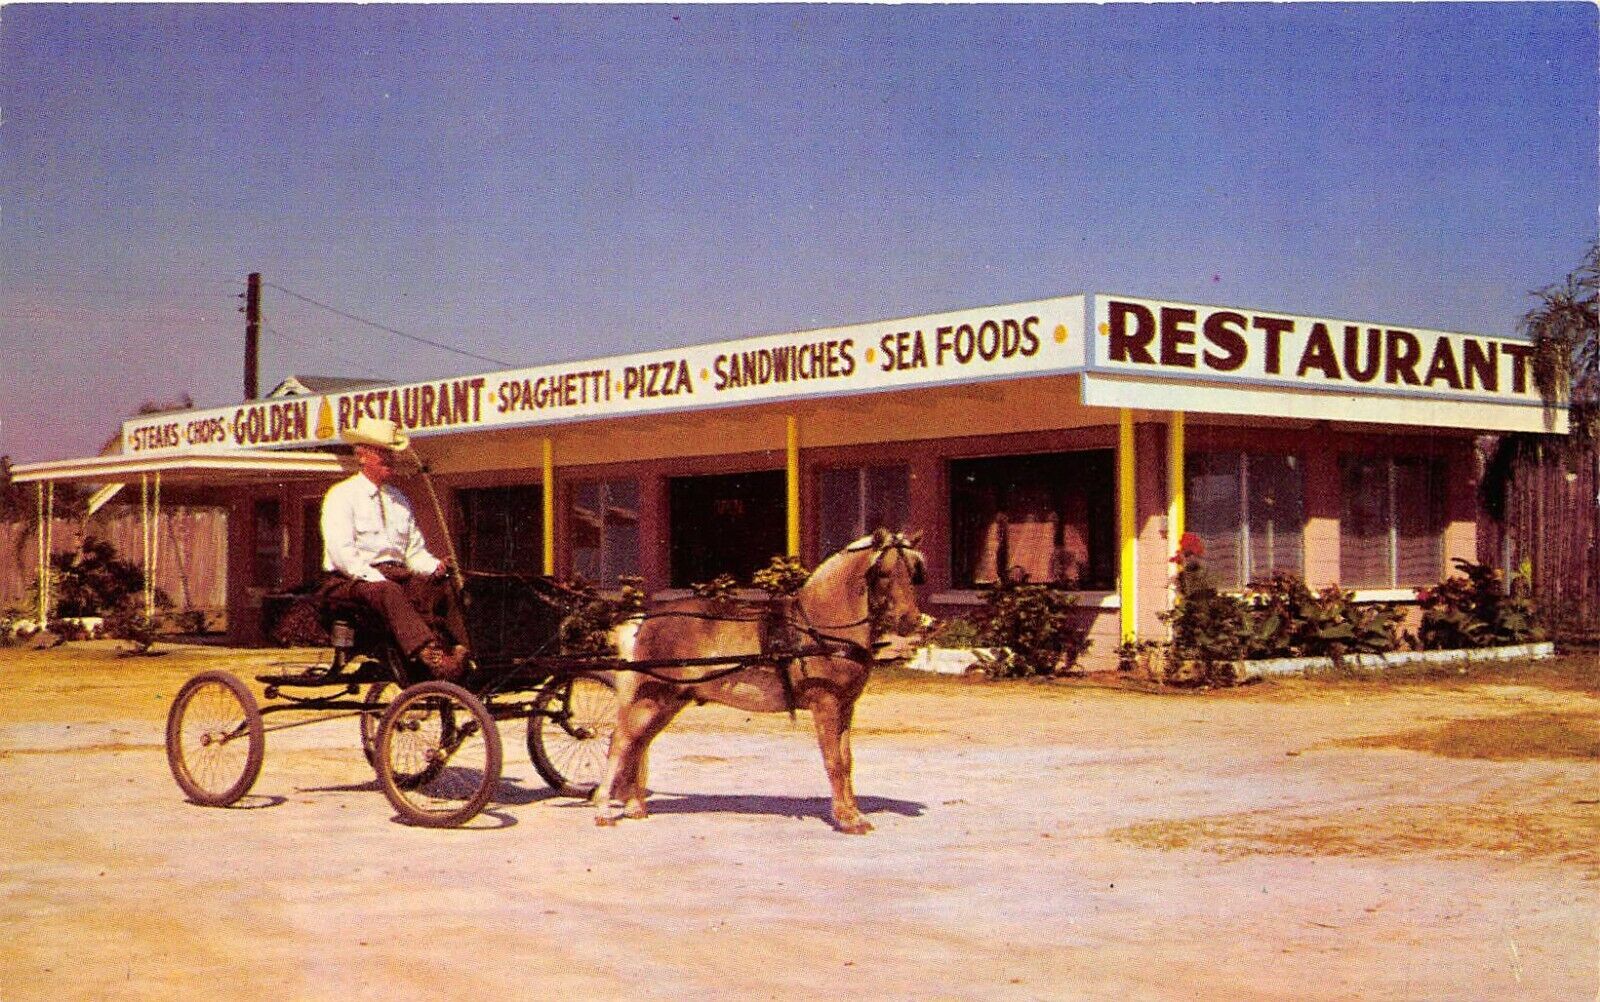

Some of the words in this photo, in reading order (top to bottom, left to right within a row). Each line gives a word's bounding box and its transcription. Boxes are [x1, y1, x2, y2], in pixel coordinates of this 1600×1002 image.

[133, 422, 178, 450] STEAKS
[187, 416, 225, 444] CHOPS
[233, 401, 307, 444] GOLDEN
[338, 378, 485, 433] RESTAURANT
[497, 370, 611, 413] SPAGHETTI
[624, 359, 693, 399] PIZZA
[713, 339, 856, 391] SANDWICHES
[880, 330, 928, 372] SEA
[935, 316, 1040, 365] FOODS
[1108, 300, 1537, 394] RESTAURANT
